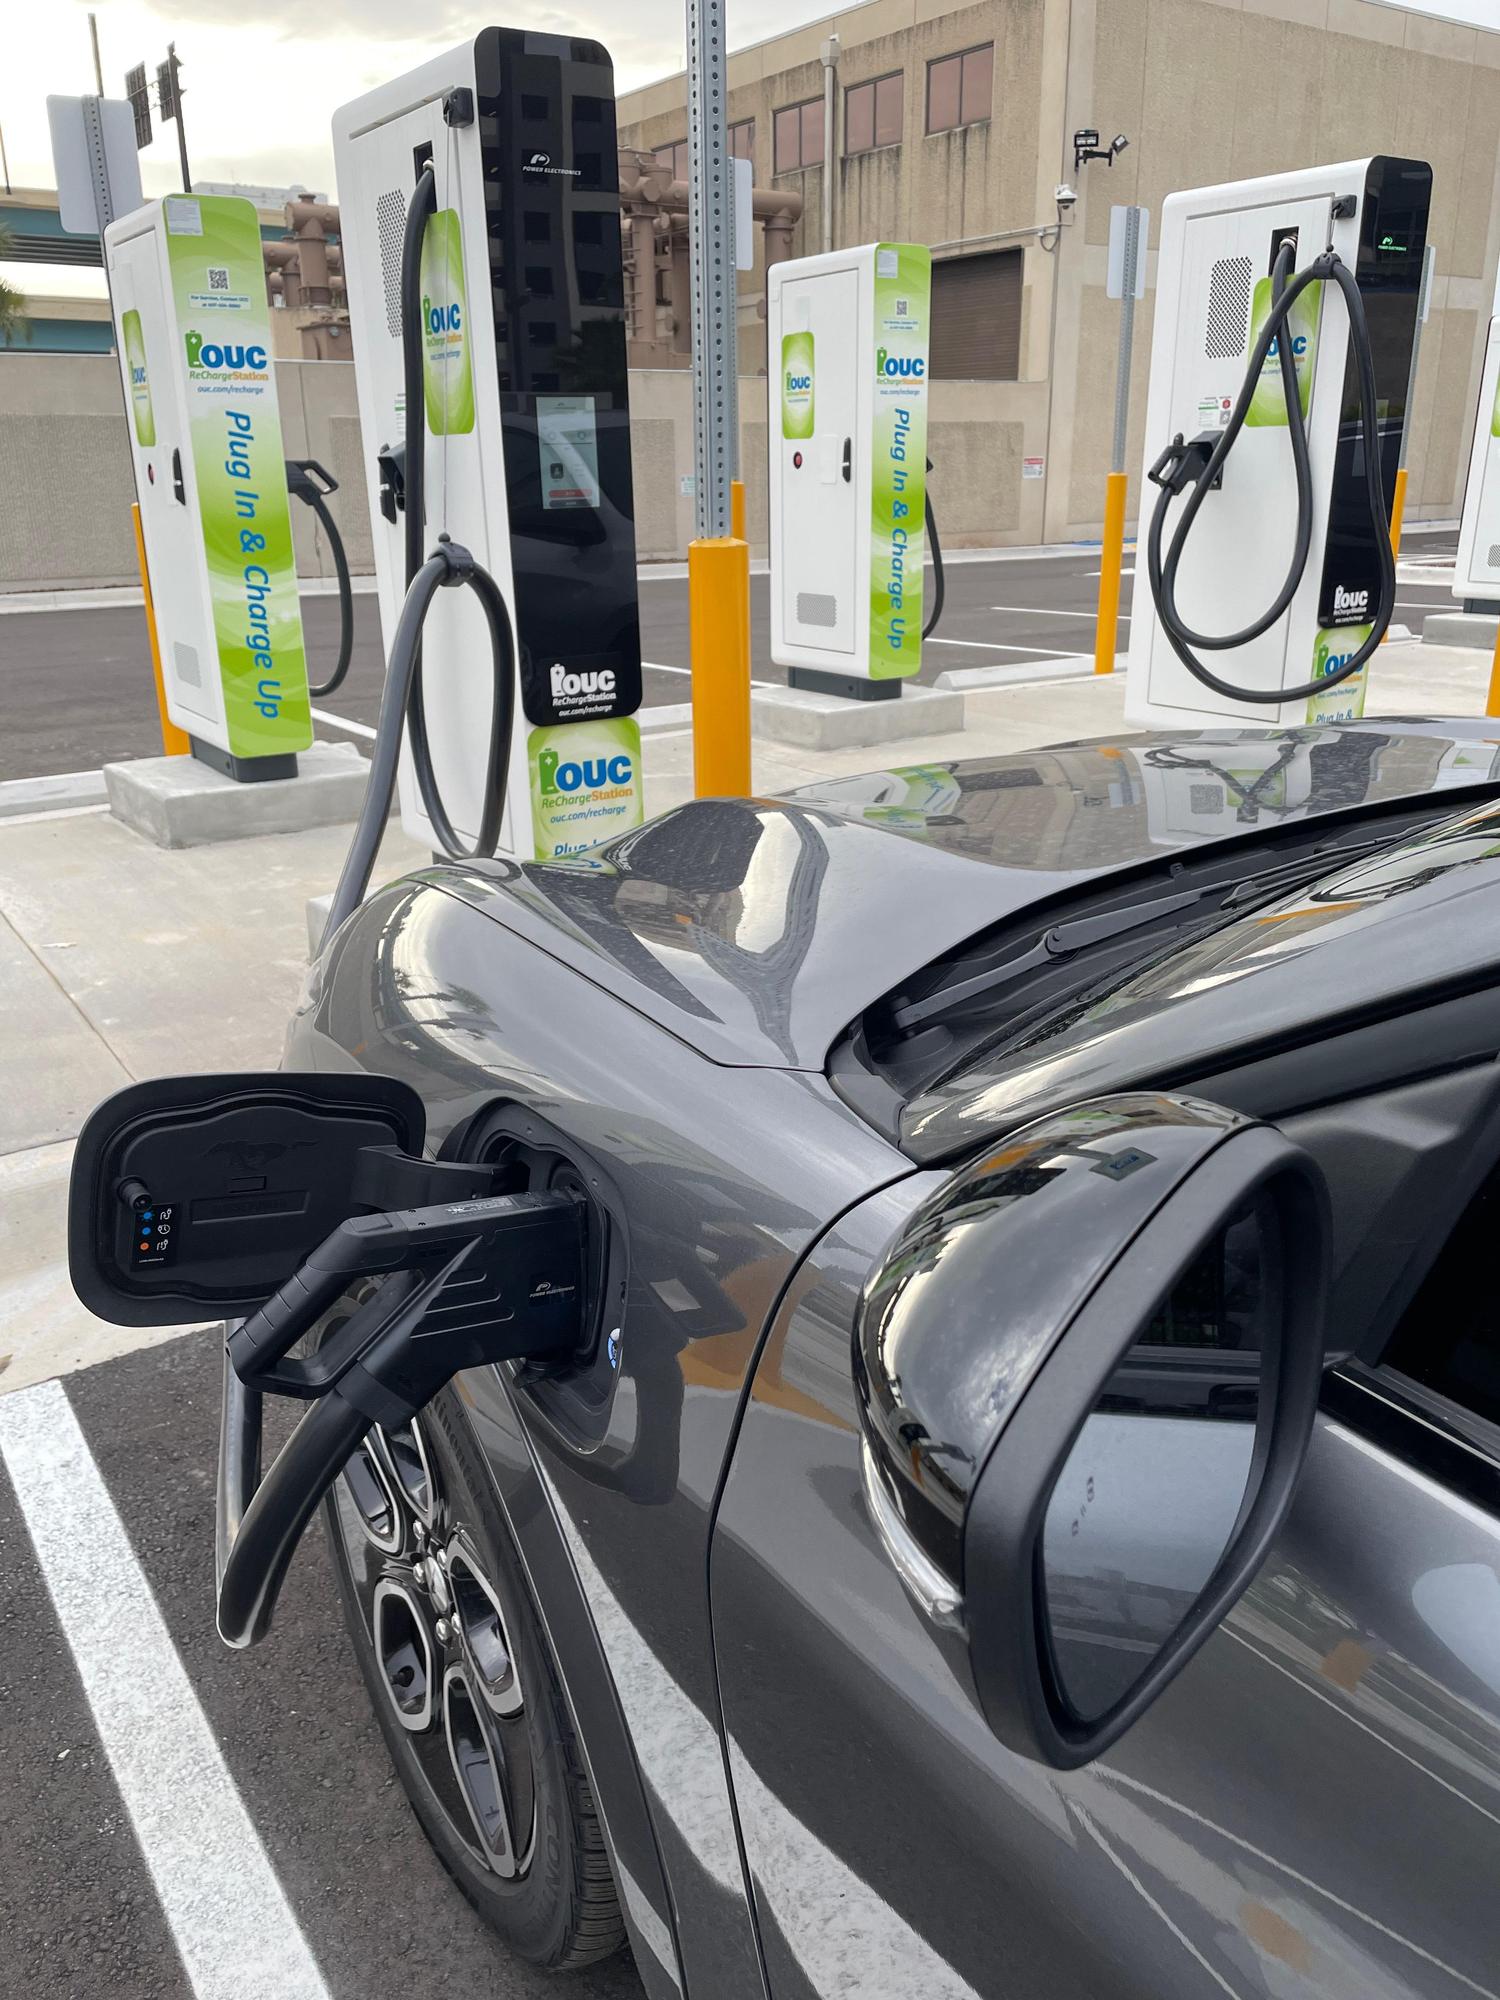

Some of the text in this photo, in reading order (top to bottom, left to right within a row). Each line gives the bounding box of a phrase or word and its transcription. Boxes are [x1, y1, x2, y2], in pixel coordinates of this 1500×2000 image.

[201, 344, 267, 369] OUC
[885, 358, 925, 376] OUC
[190, 371, 269, 381] ReChargeStation
[887, 408, 910, 649] Plug In & Charge Up
[225, 410, 281, 720] Plug In & Charge Up
[562, 669, 616, 695] OUC
[552, 692, 617, 706] ReChargeStation
[558, 704, 613, 717] ouc.com/recharge
[556, 755, 632, 791] OUC
[541, 788, 633, 809] ReChargeStation
[550, 805, 626, 824] ouc.com/recharge
